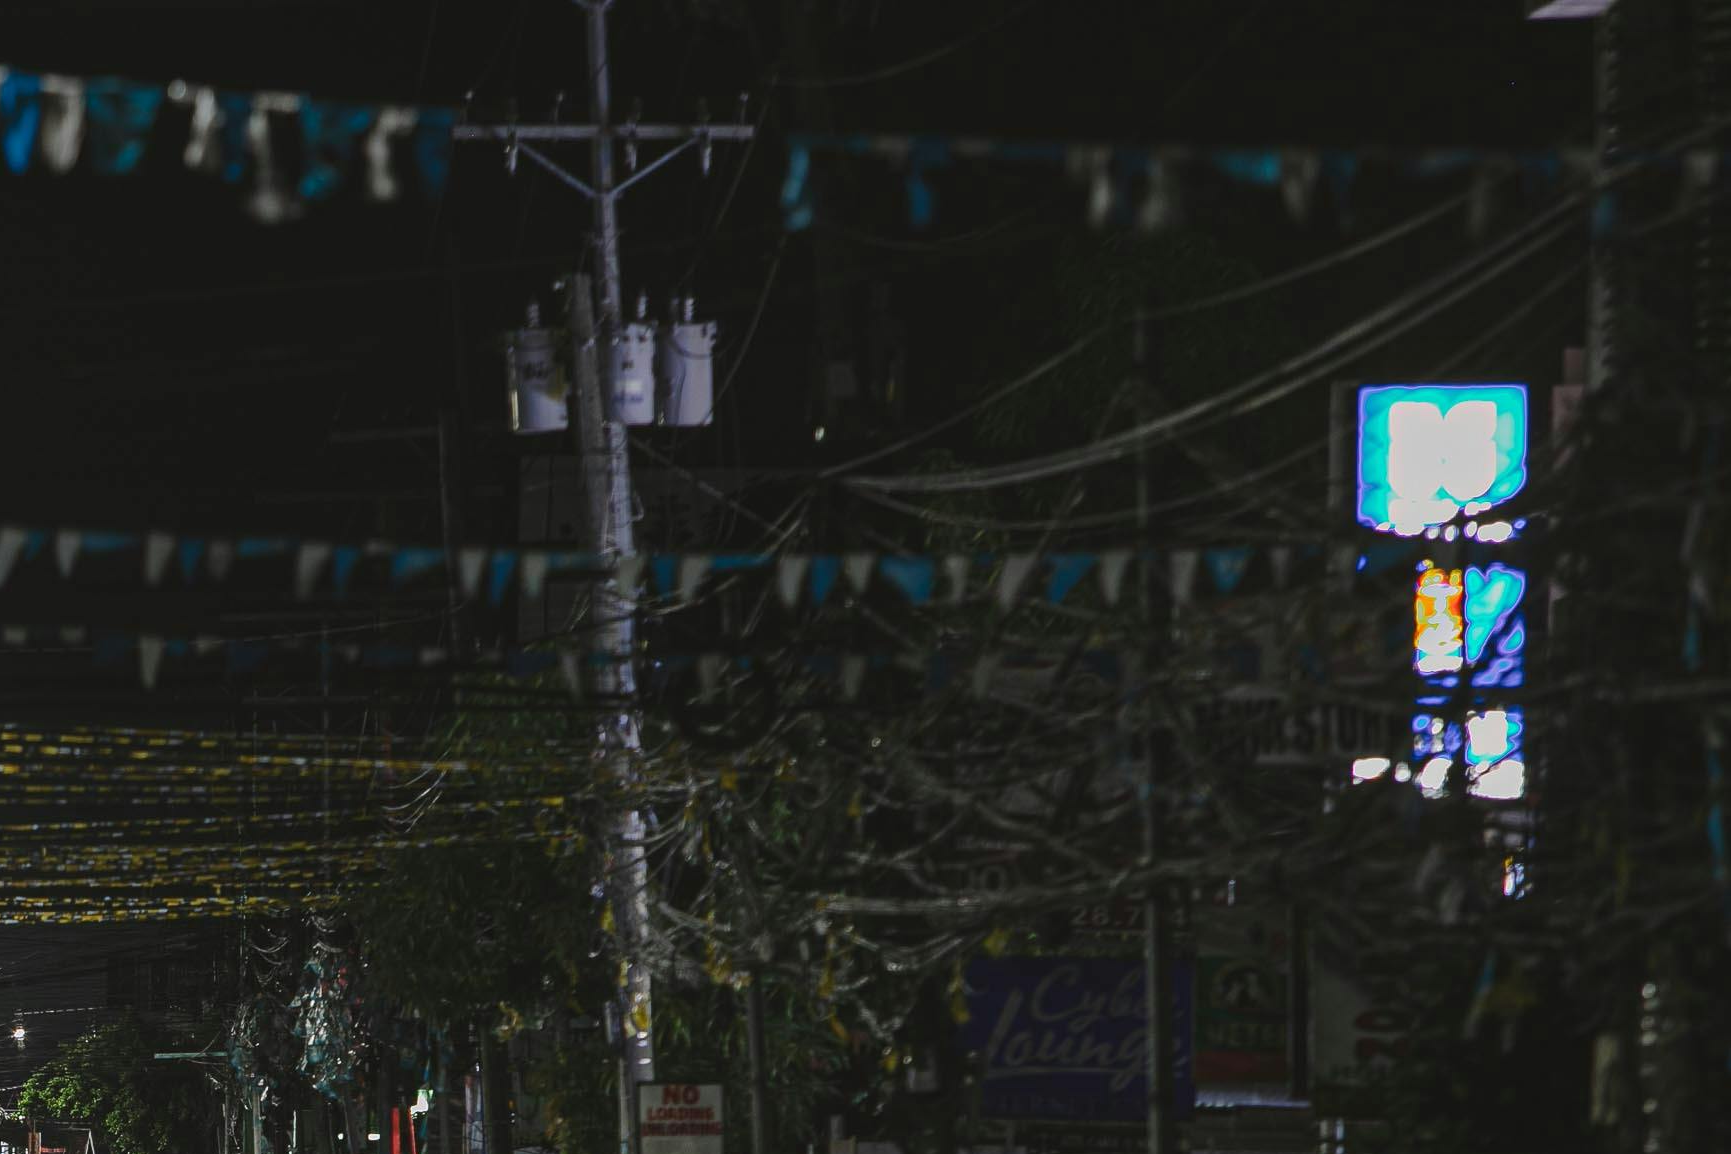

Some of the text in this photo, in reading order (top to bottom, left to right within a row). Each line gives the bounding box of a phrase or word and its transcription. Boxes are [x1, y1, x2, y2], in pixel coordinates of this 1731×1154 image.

[663, 1084, 701, 1105] NO
[646, 1106, 715, 1121] LOADING
[640, 1122, 724, 1137] UNLOADING
